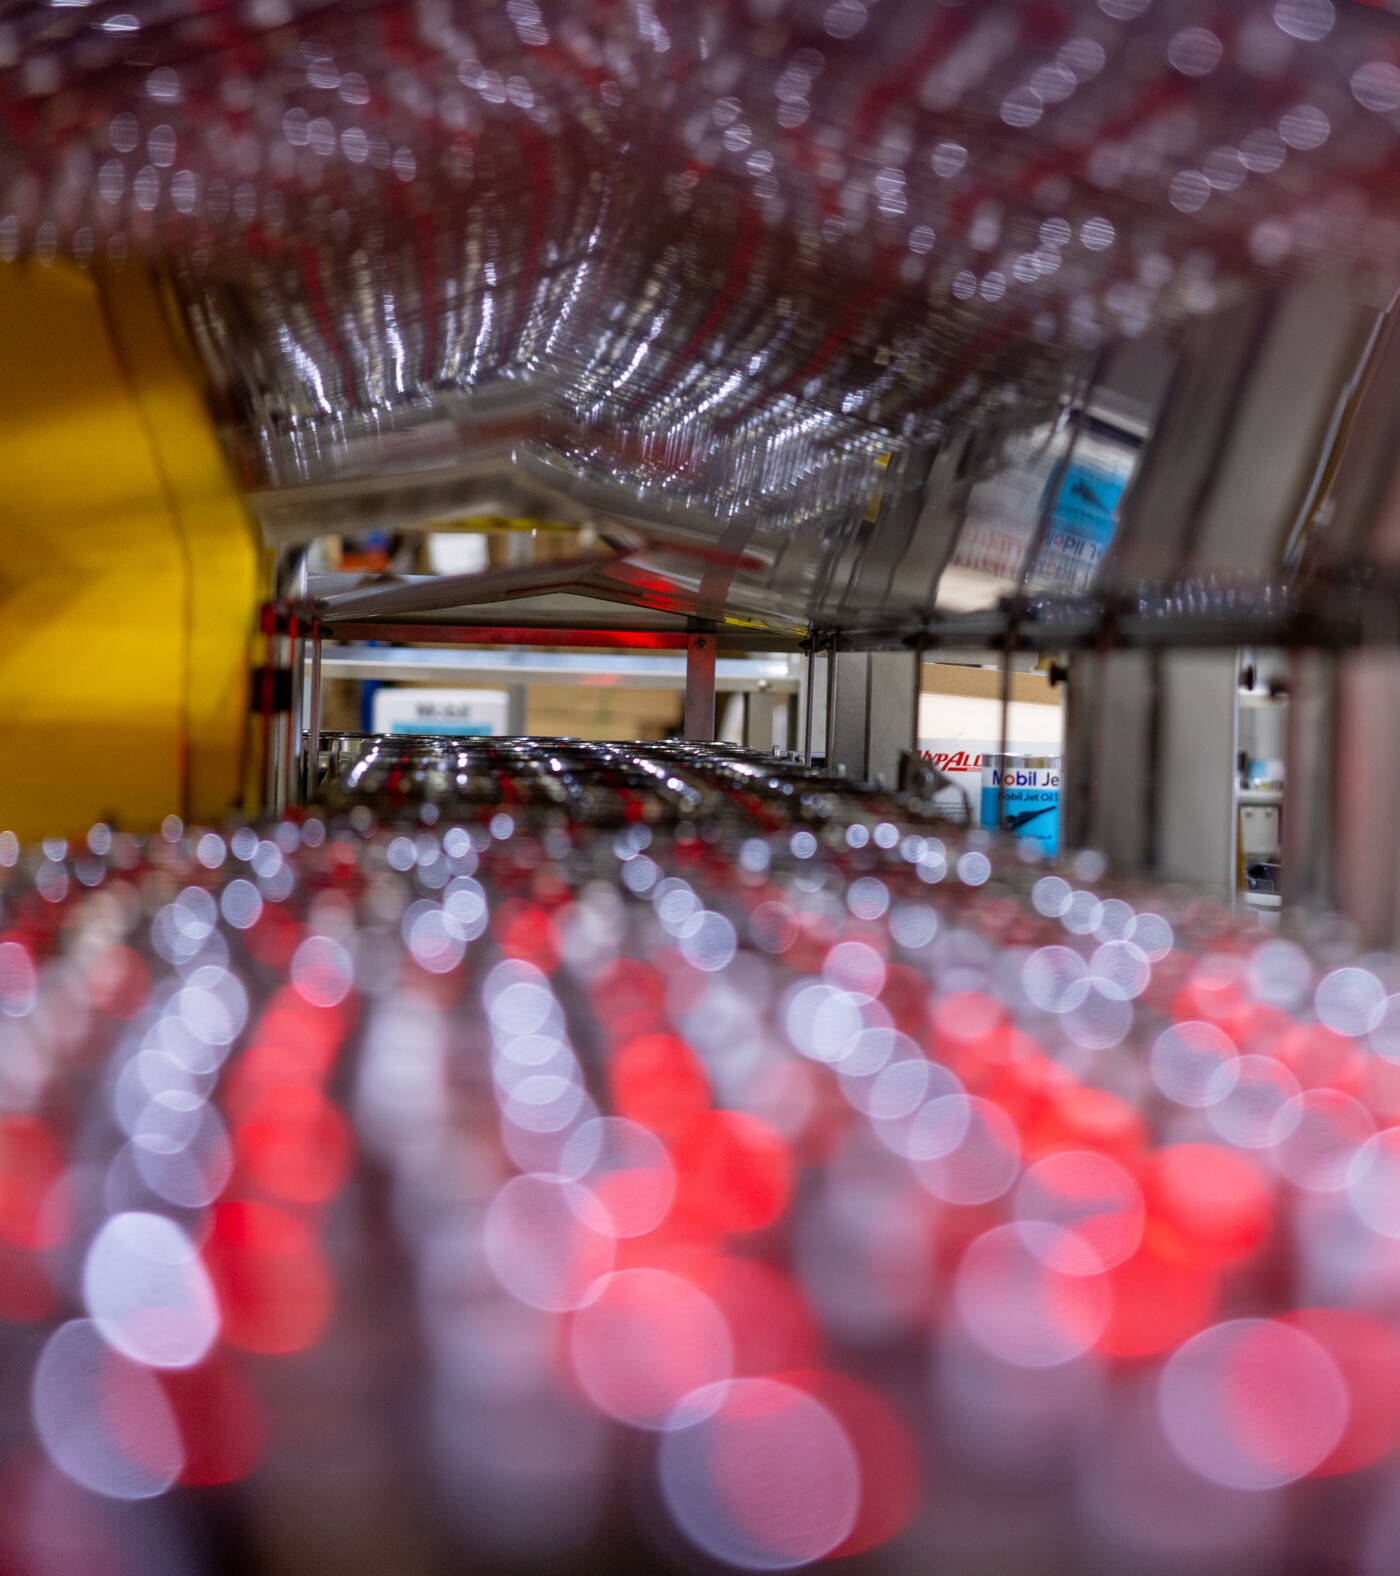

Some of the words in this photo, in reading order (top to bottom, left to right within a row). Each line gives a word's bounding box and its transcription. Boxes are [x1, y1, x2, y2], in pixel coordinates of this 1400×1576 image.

[992, 769, 1037, 786] Mobil
[1041, 771, 1060, 787] Je
[1000, 791, 1023, 801] obil
